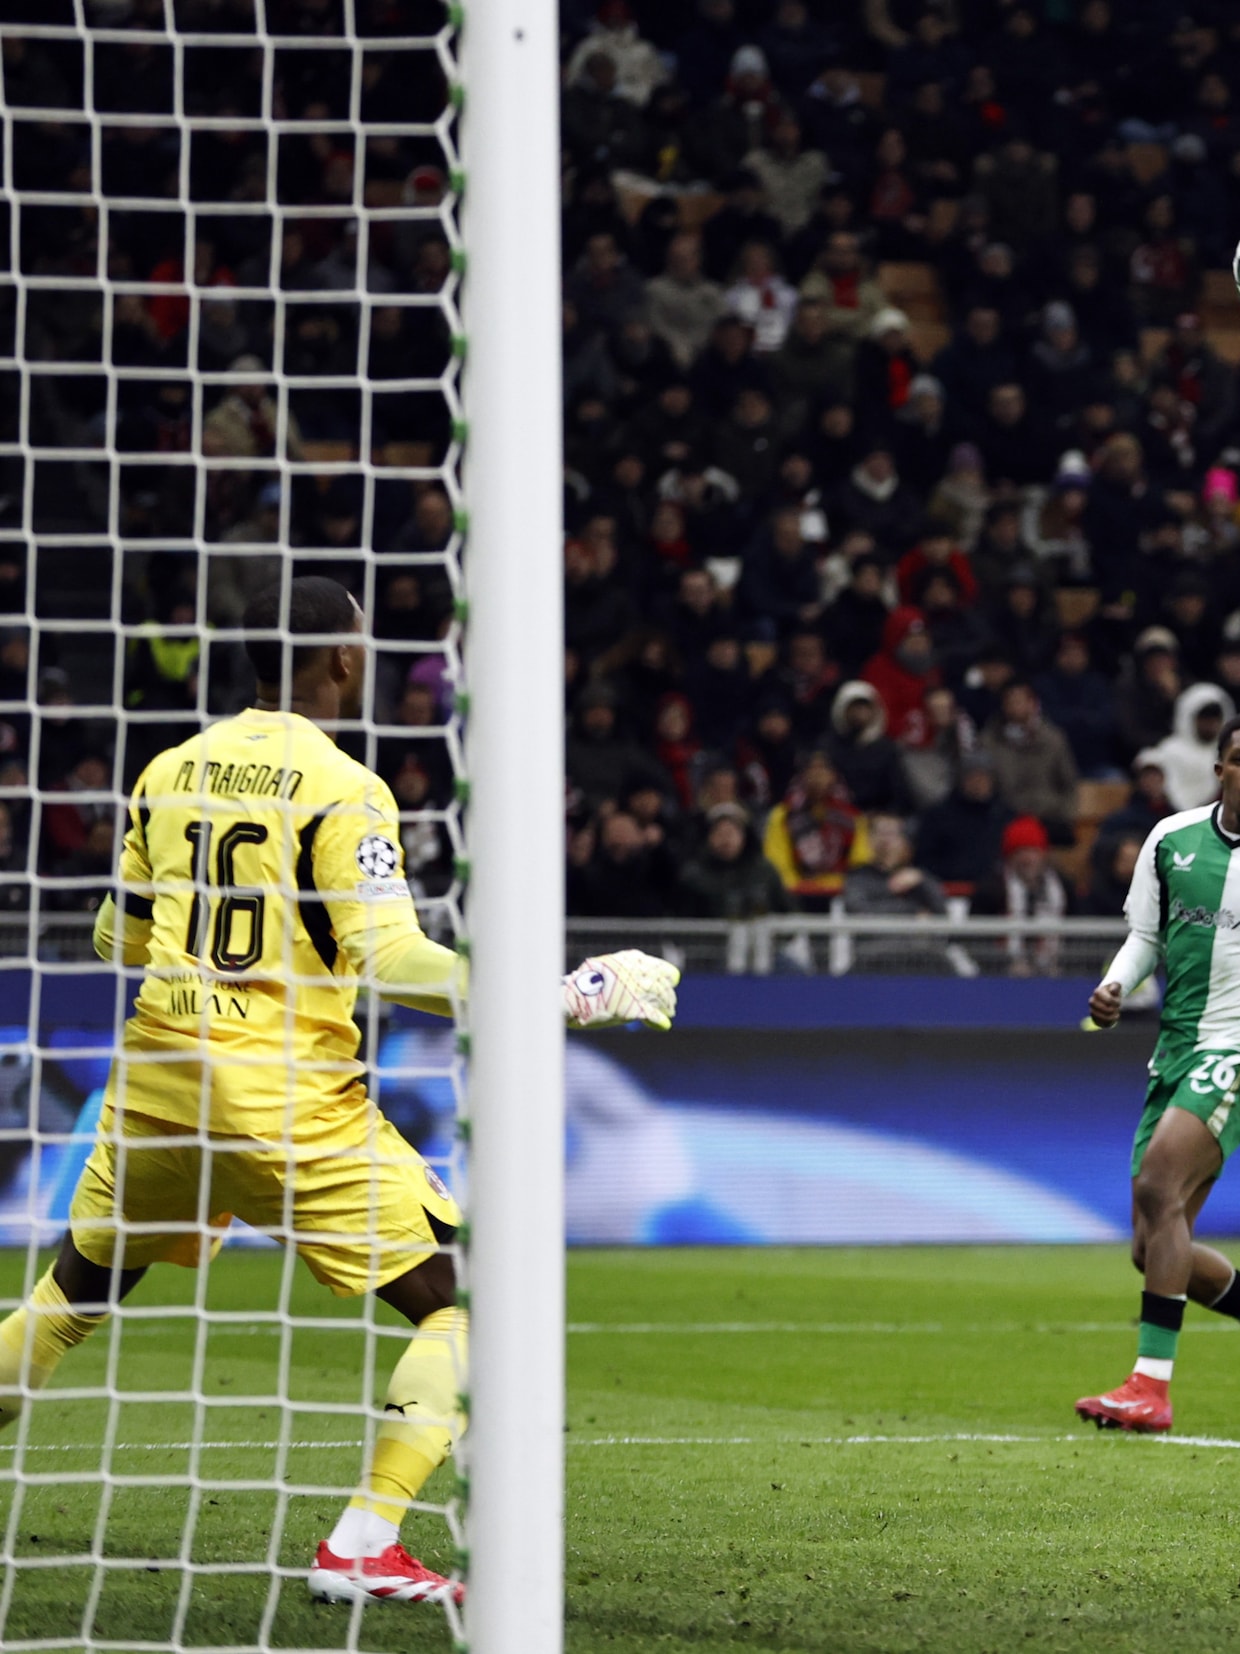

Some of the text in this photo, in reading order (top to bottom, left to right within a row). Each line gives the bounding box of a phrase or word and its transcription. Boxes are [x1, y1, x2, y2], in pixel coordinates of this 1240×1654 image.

[172, 760, 304, 802] M. MAIGNAN
[185, 821, 269, 972] 16
